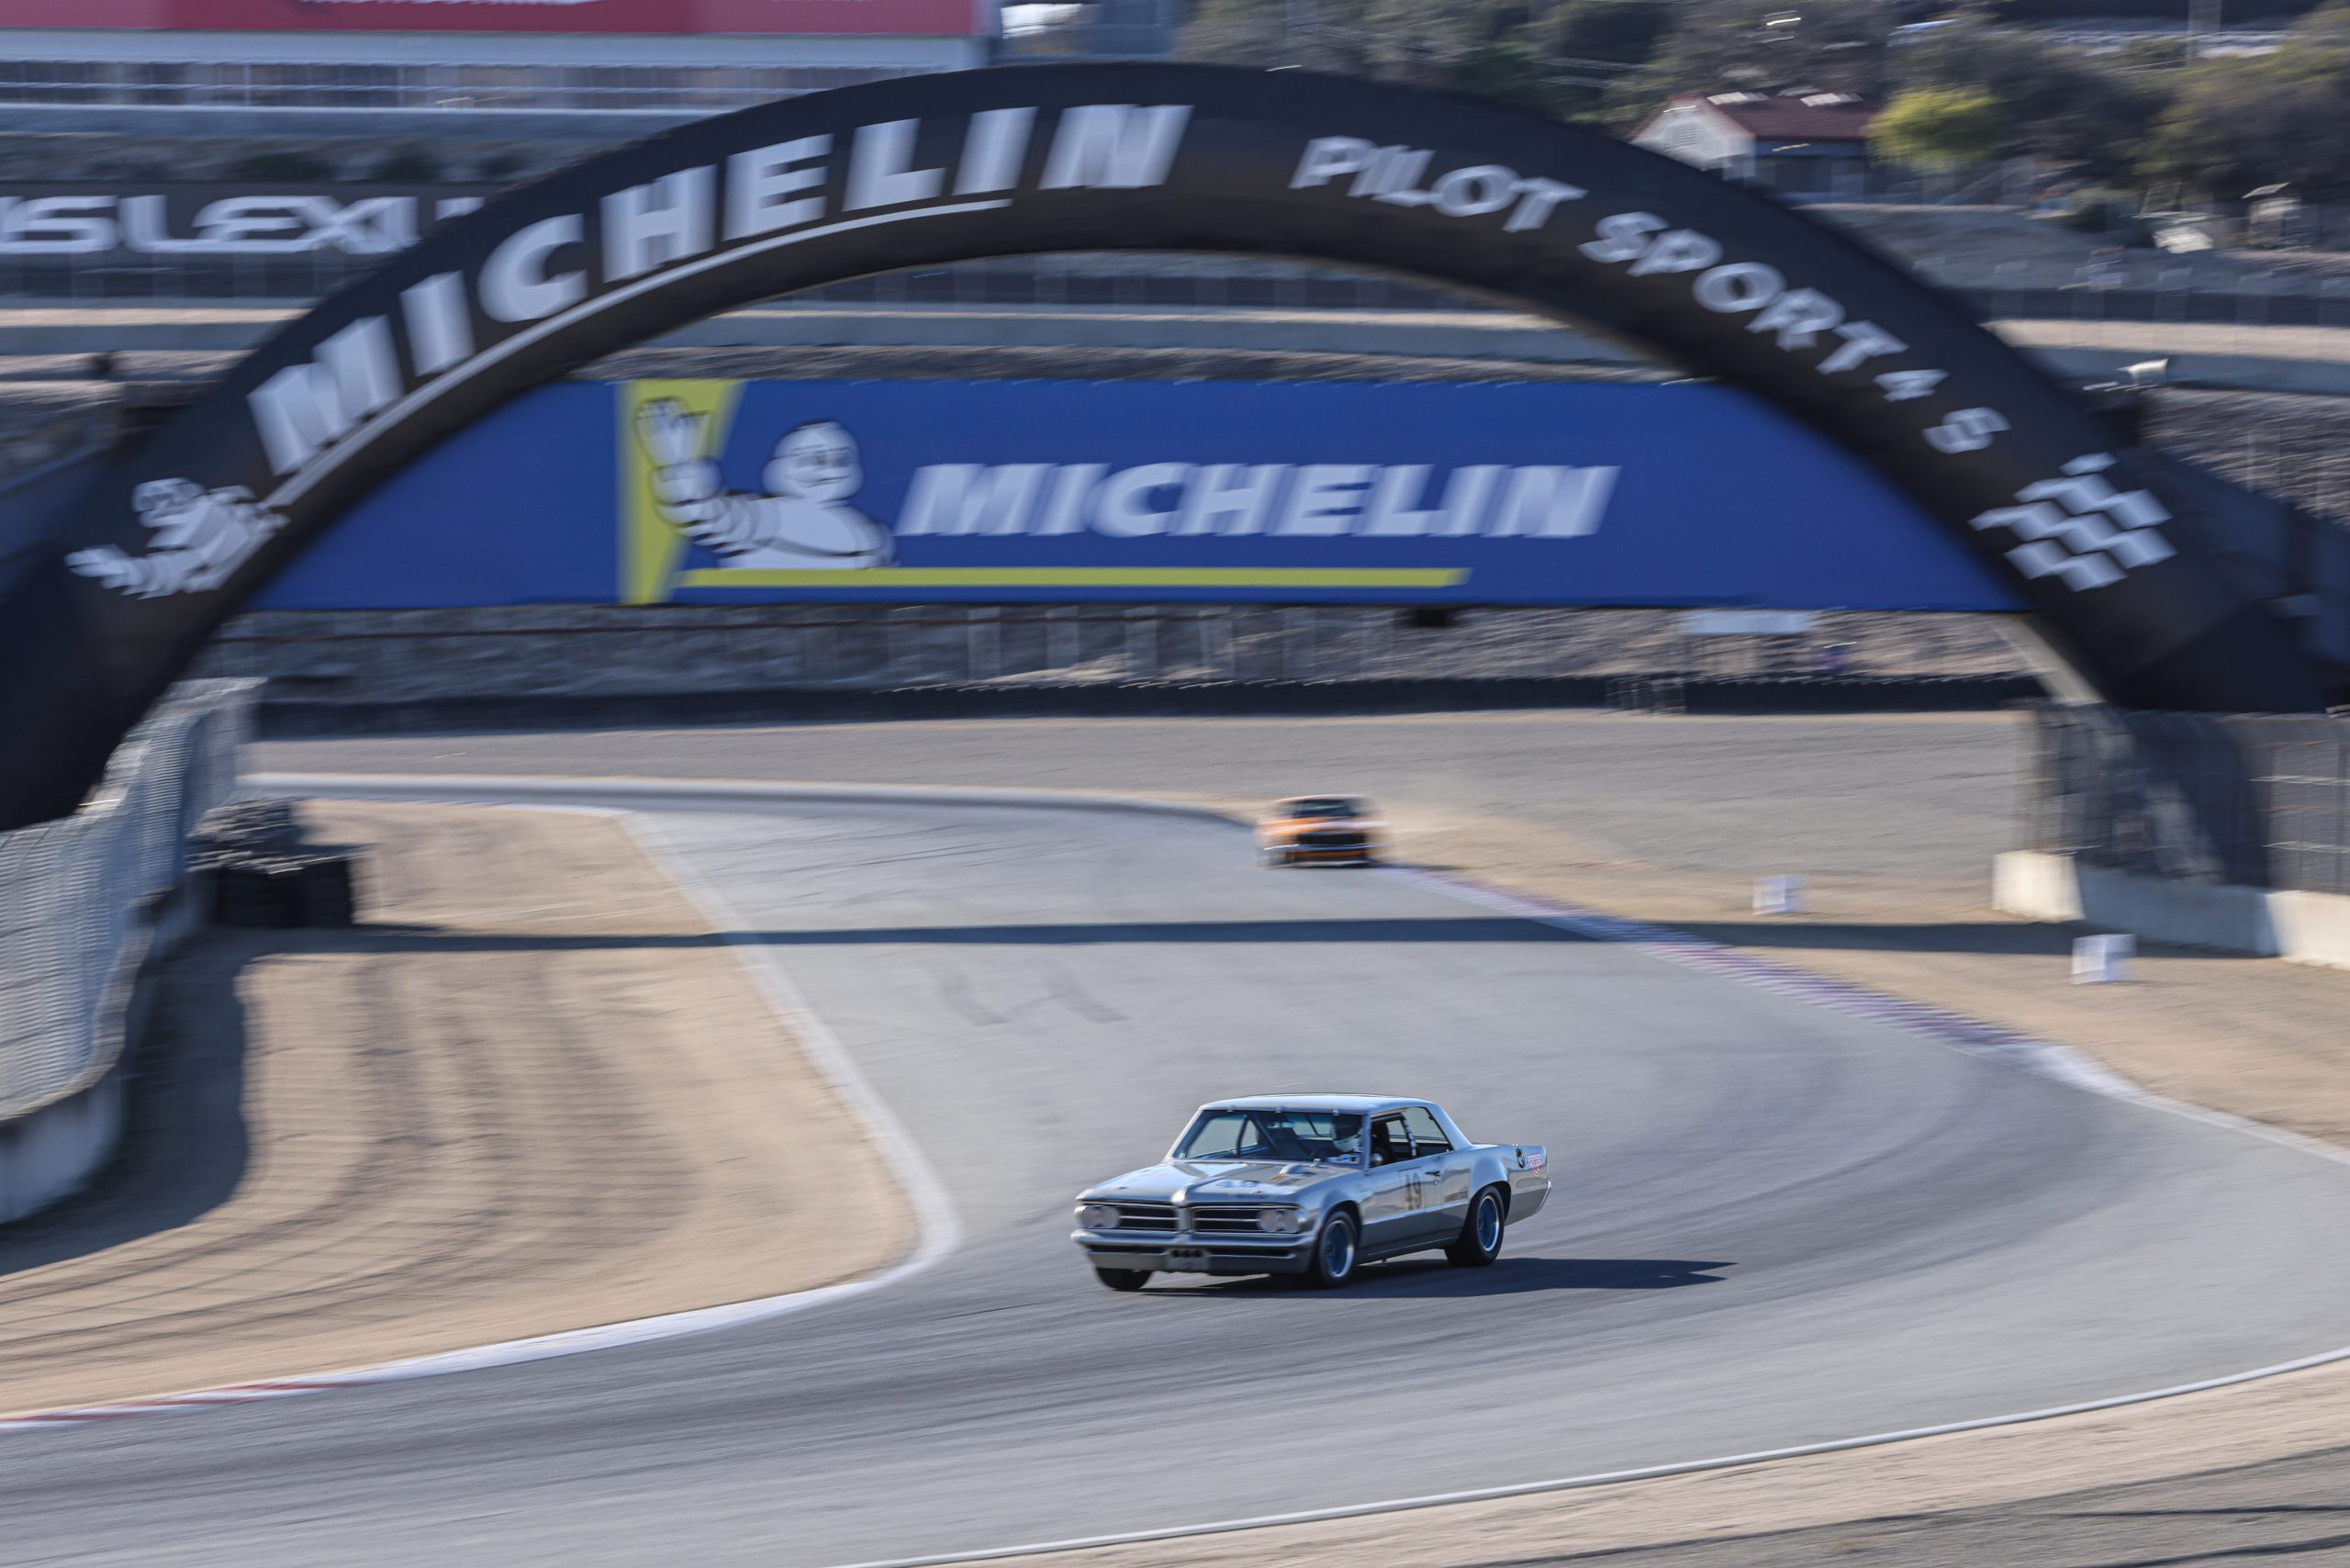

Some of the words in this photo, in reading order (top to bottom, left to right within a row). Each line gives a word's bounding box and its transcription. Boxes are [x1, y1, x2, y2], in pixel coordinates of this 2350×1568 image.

[247, 104, 1193, 476] MICHELIN
[1290, 135, 1587, 232] PILOT
[1577, 211, 1909, 375] SPORT
[1921, 407, 2012, 454] S
[893, 462, 1621, 539] MICHELIN
